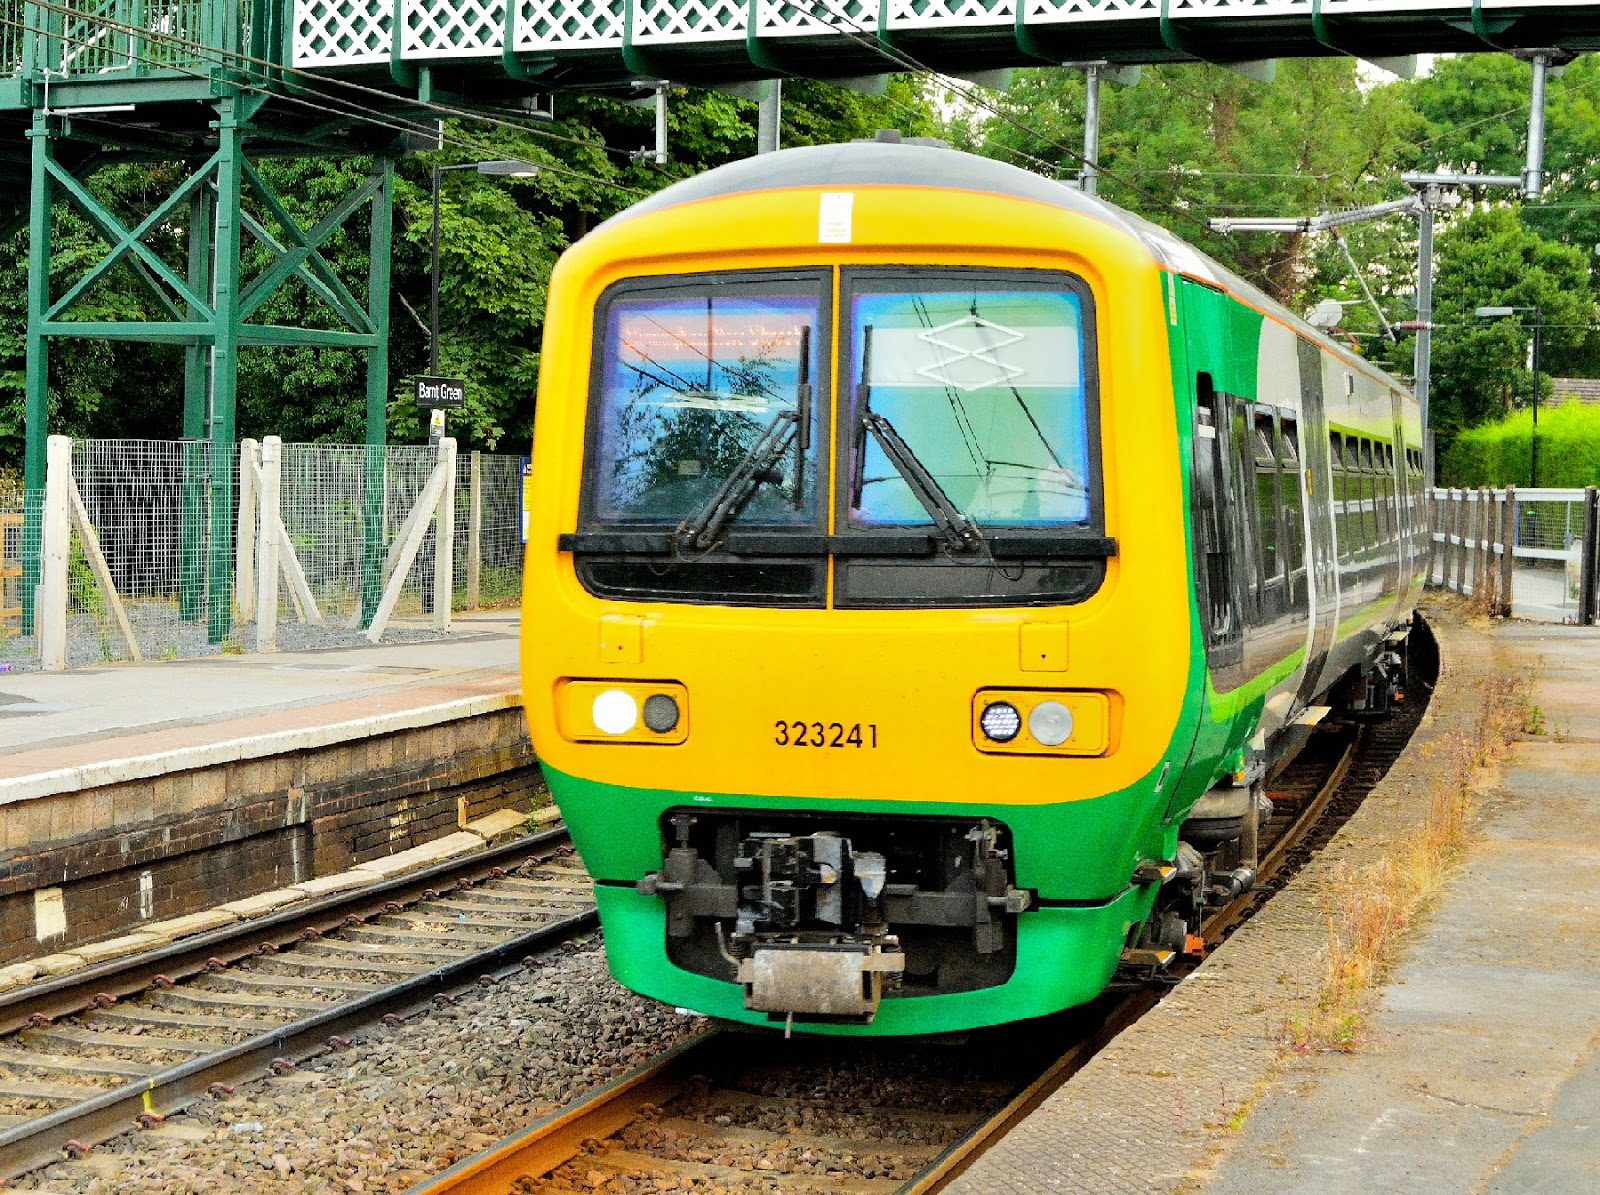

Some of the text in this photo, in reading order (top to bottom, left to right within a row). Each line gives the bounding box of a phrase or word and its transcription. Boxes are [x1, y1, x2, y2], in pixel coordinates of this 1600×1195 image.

[419, 382, 462, 400] Barnt Green
[775, 720, 876, 748] 323241
